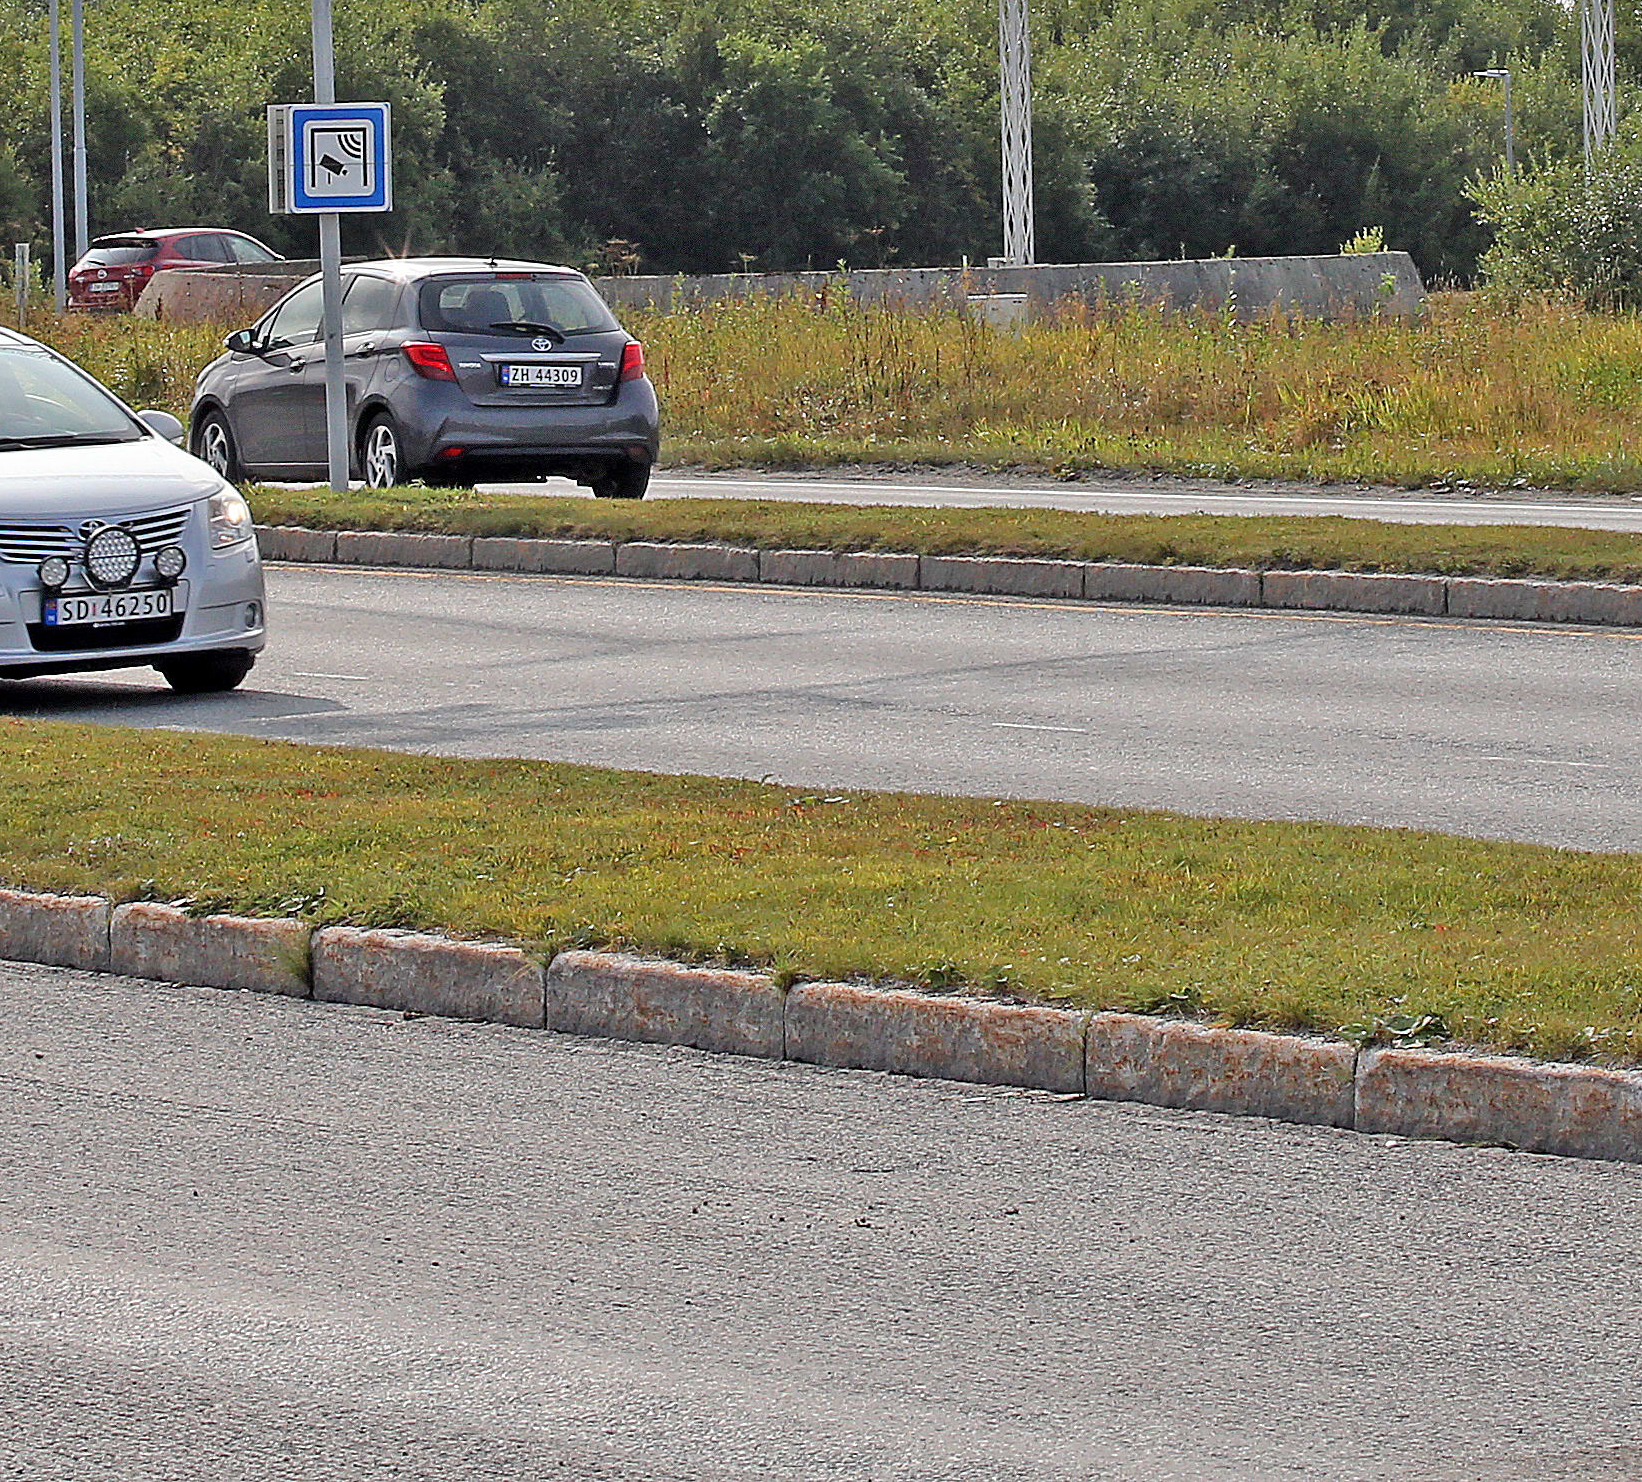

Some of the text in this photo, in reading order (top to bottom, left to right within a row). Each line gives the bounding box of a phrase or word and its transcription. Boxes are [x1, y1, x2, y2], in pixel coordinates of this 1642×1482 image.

[512, 368, 578, 383] ZH 44309
[62, 593, 167, 621] SD 46250
